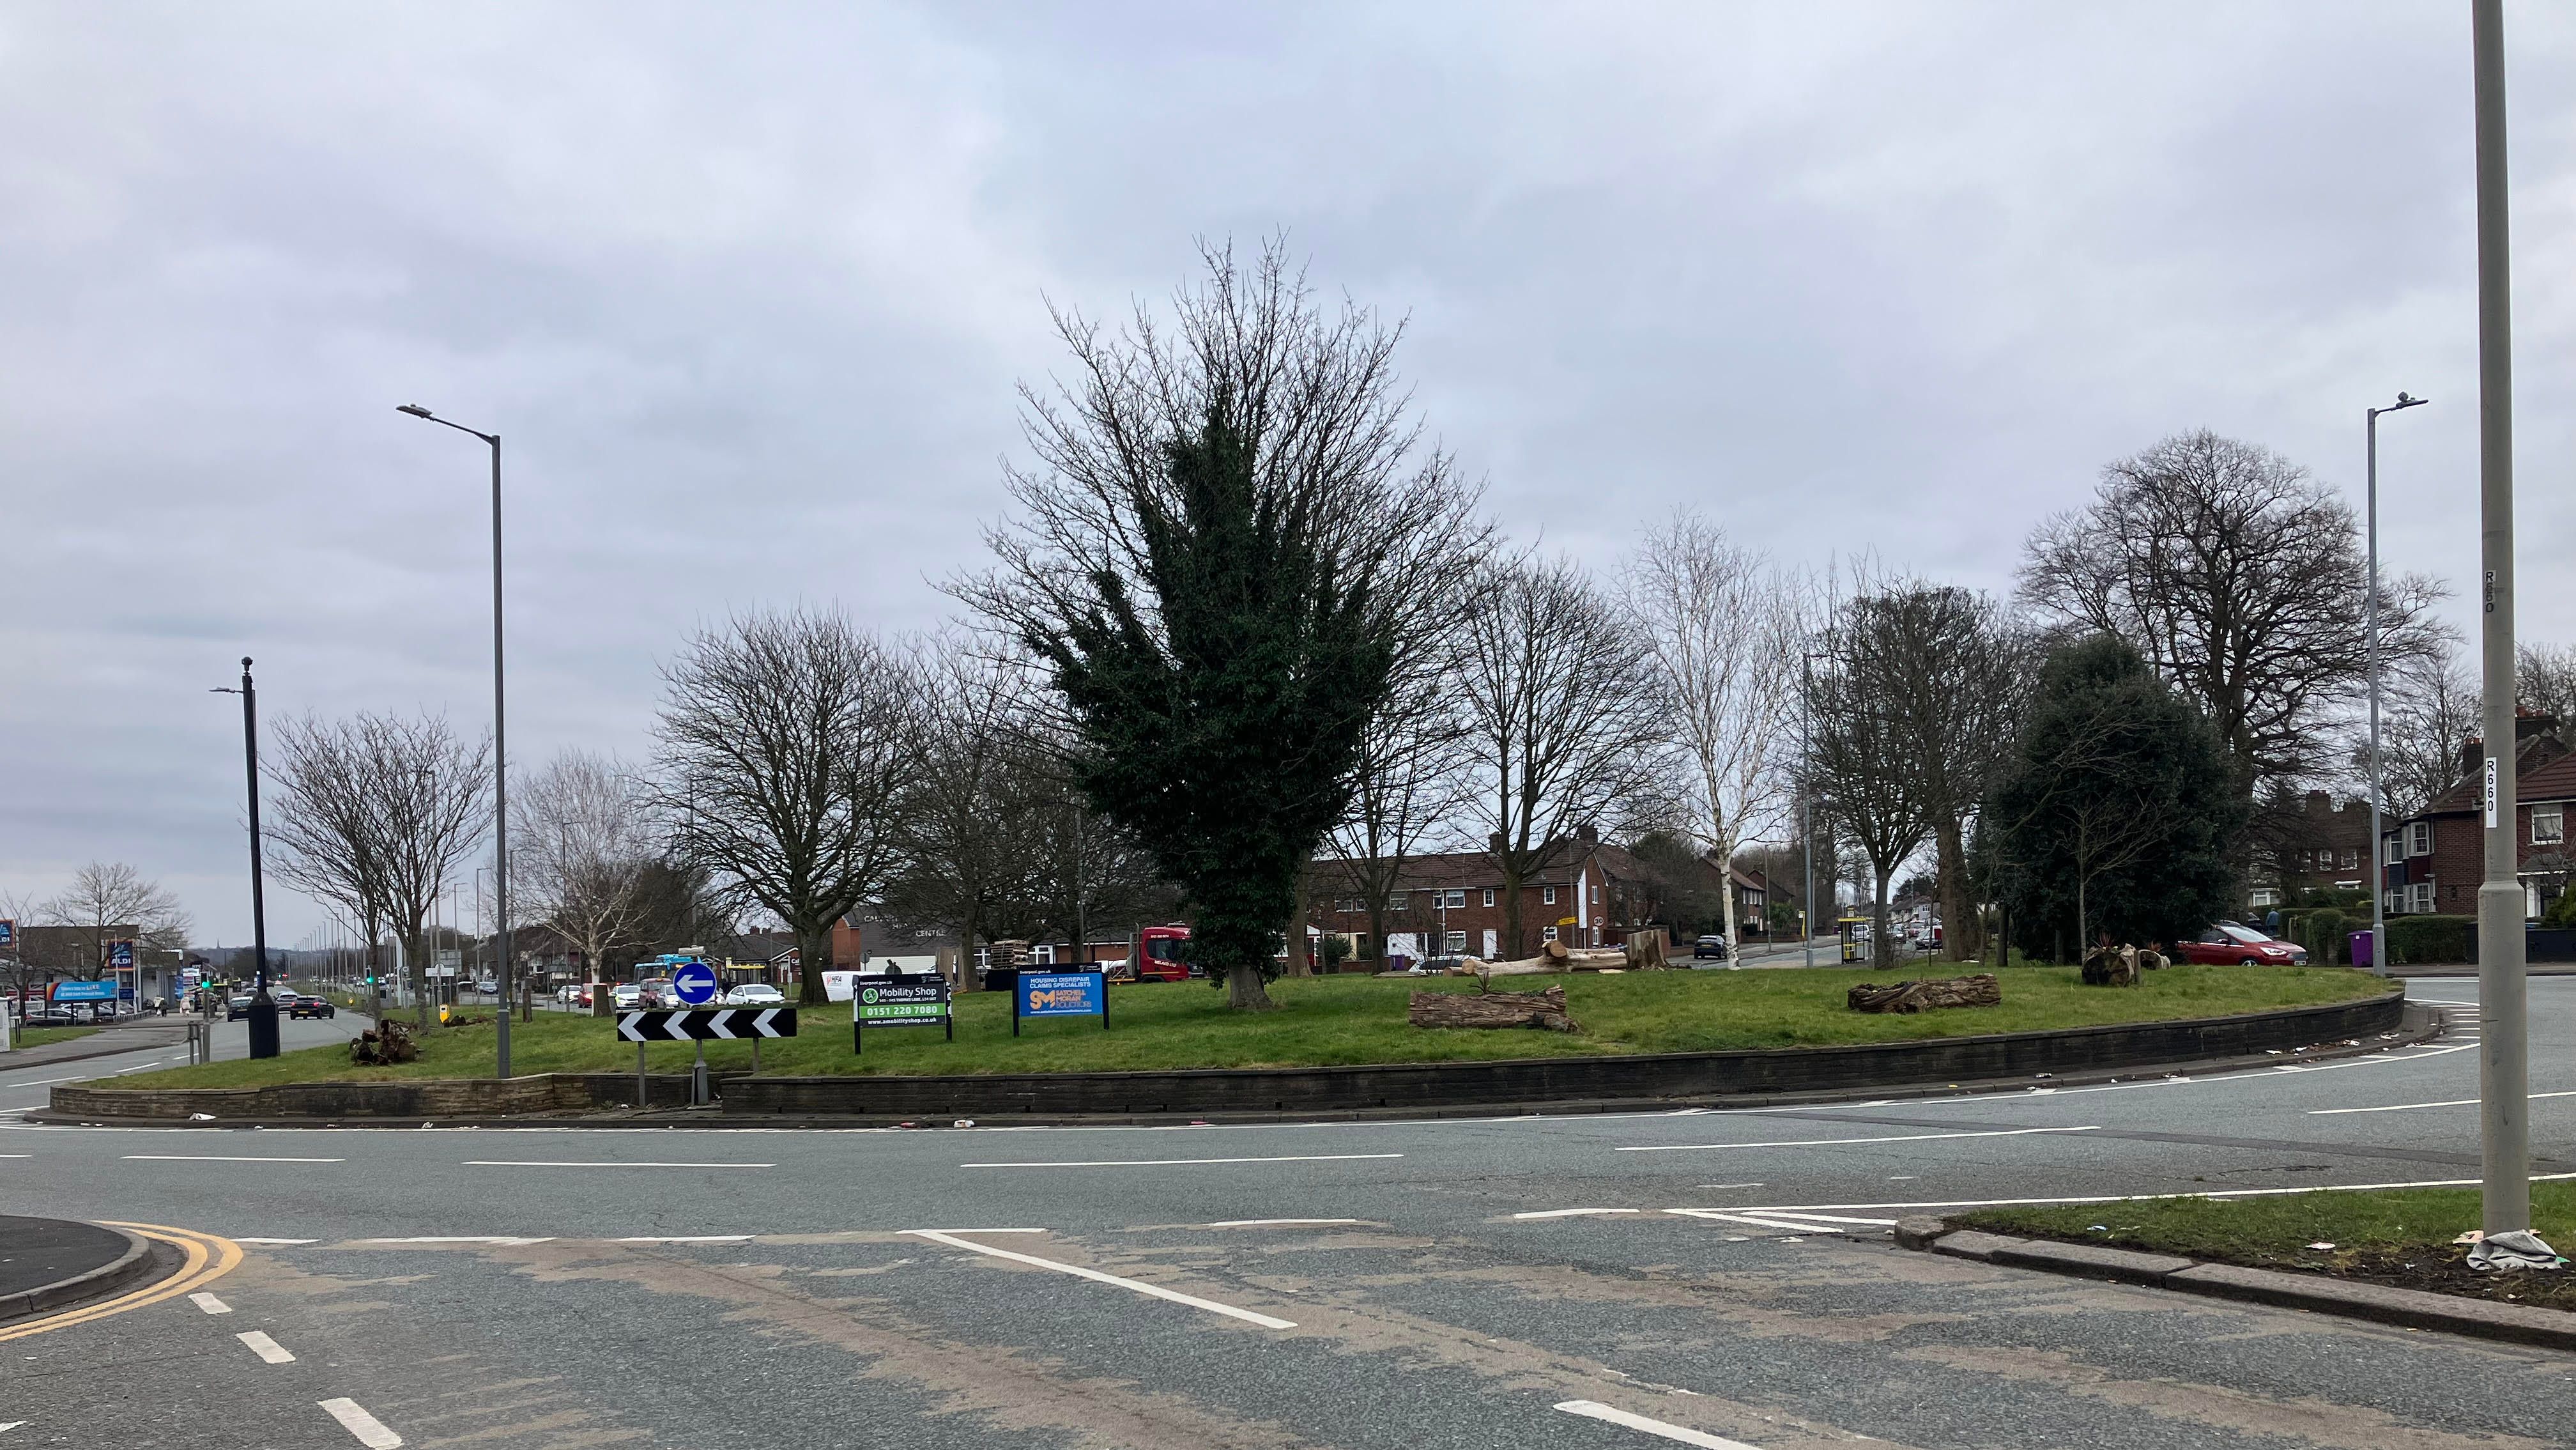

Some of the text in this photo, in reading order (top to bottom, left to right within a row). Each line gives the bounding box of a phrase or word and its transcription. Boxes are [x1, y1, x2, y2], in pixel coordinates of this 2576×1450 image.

[880, 987, 937, 997] Mobility Shop
[894, 1007, 911, 1015] 220
